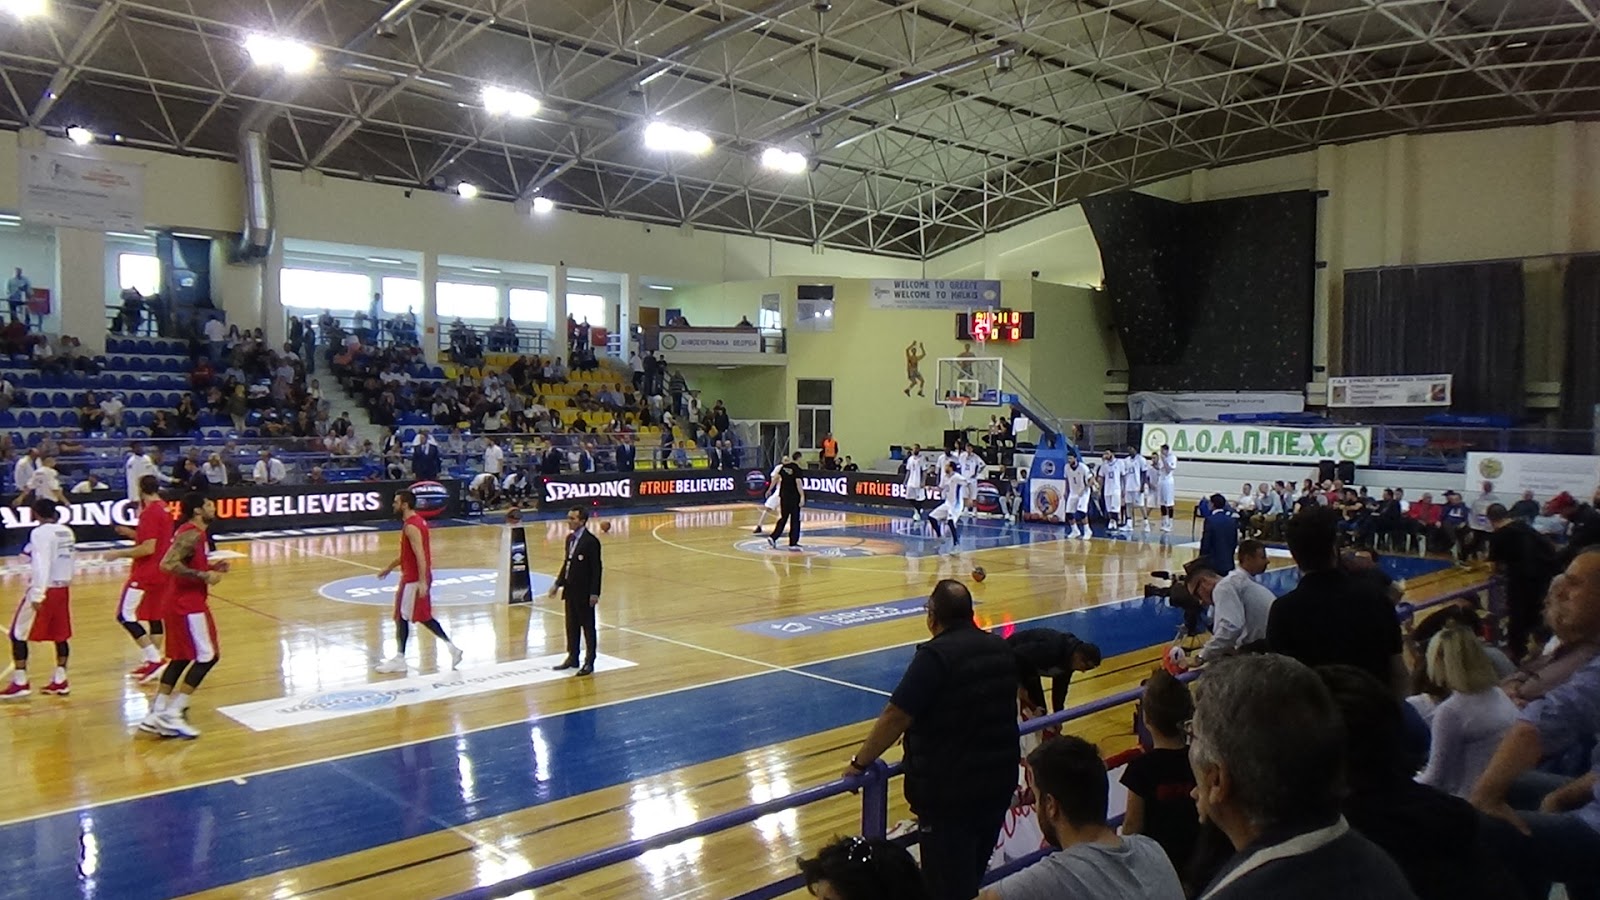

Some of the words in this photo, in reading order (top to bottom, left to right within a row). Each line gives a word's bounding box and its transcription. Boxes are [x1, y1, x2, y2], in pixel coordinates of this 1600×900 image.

[894, 280, 929, 290] WELCOME
[934, 281, 945, 290] TO
[949, 281, 978, 290] GREECE
[894, 290, 931, 299] WELCOME
[936, 291, 946, 299] TO
[545, 478, 631, 502] SPALDING
[639, 477, 735, 495] #TRUEBELIEVERS
